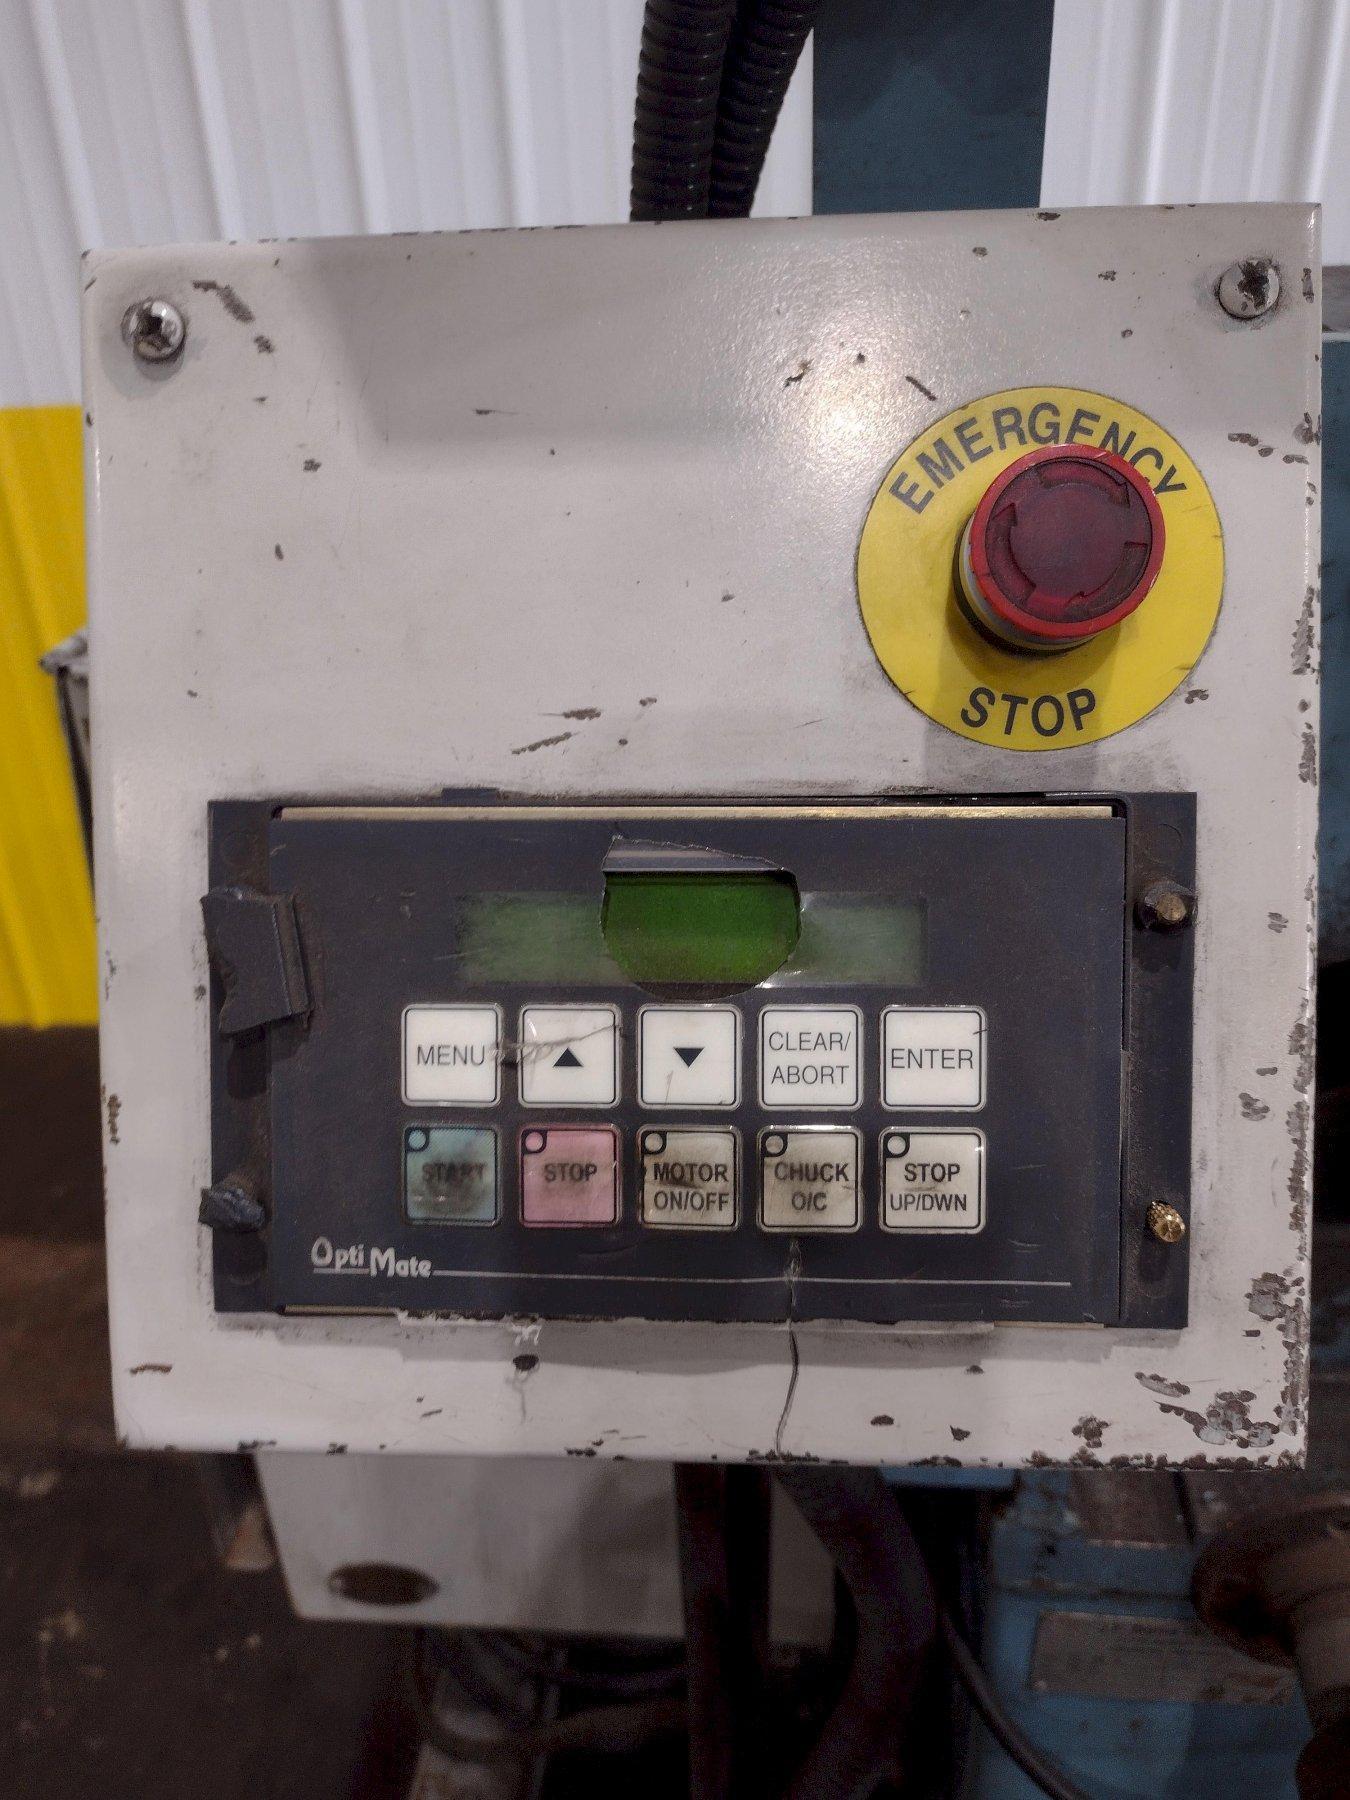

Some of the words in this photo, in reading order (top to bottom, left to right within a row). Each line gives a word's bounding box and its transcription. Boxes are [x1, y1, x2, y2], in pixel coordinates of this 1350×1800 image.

[888, 401, 1188, 515] EMERGENCY
[960, 686, 1097, 737] STOP
[768, 1031, 852, 1051] CLEAR/
[416, 1044, 486, 1067] MENU
[890, 1048, 974, 1070] ENTER
[770, 1065, 850, 1085] ABORT
[543, 1162, 598, 1182] STOP
[653, 1162, 729, 1182] MOTOR
[773, 1162, 850, 1183] CHUCK
[903, 1162, 961, 1183] STOP
[653, 1190, 730, 1212] ON/OFF
[791, 1191, 828, 1212] O/C
[889, 1193, 968, 1212] UP/DWN
[310, 1236, 365, 1273] Opti
[369, 1246, 433, 1279] Mate
